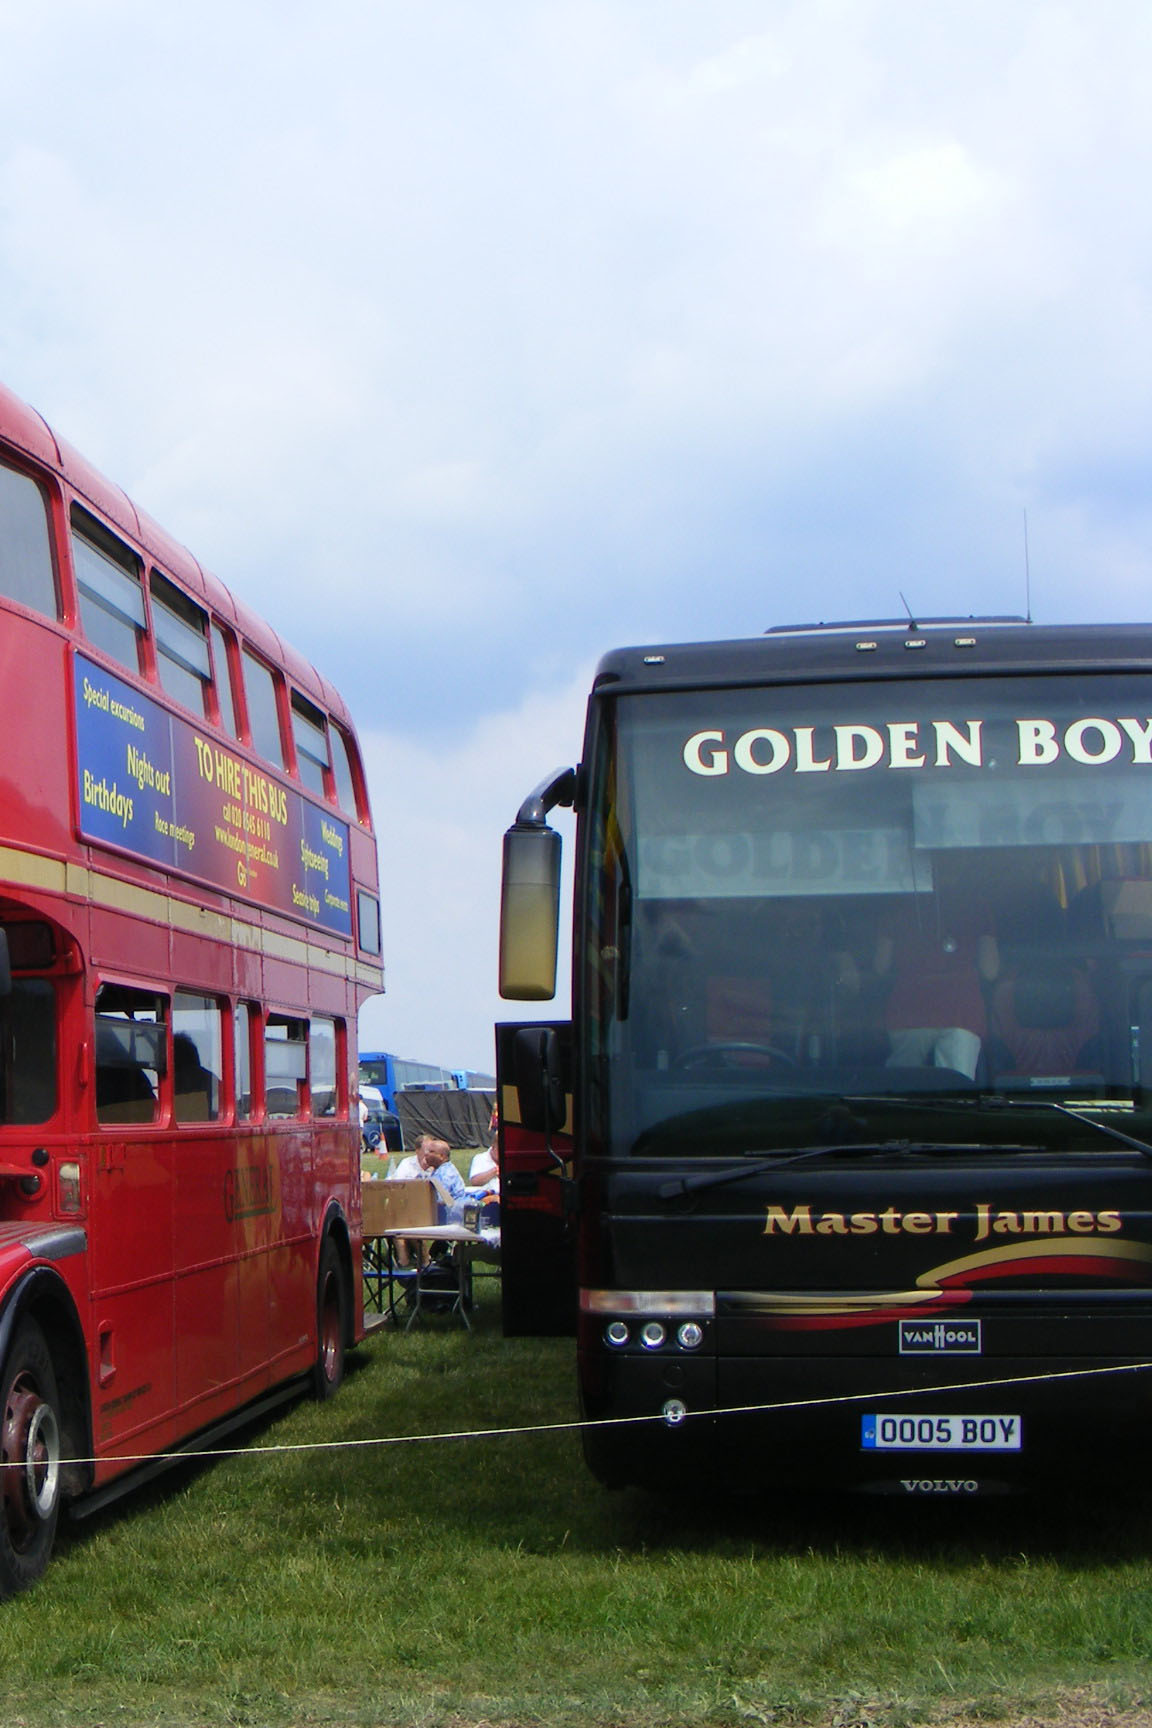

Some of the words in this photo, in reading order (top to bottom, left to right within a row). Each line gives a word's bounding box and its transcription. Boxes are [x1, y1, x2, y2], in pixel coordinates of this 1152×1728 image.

[83, 677, 109, 712] Special
[110, 699, 145, 731] excursions
[127, 743, 154, 791] Nights
[155, 767, 171, 796] out
[682, 719, 983, 777] GOLDEN
[1015, 716, 1152, 766] BOY
[83, 769, 133, 828] Birthdays
[194, 735, 213, 783] TO
[215, 749, 241, 801] HIRE
[242, 766, 268, 814] THIS
[269, 783, 288, 825] BUS
[154, 810, 168, 836] Race
[169, 821, 195, 851] meetings
[763, 1205, 959, 1234] Master
[973, 1203, 1122, 1242] James
[961, 1418, 1015, 1443] BOY
[900, 1480, 979, 1492] VOLVO
